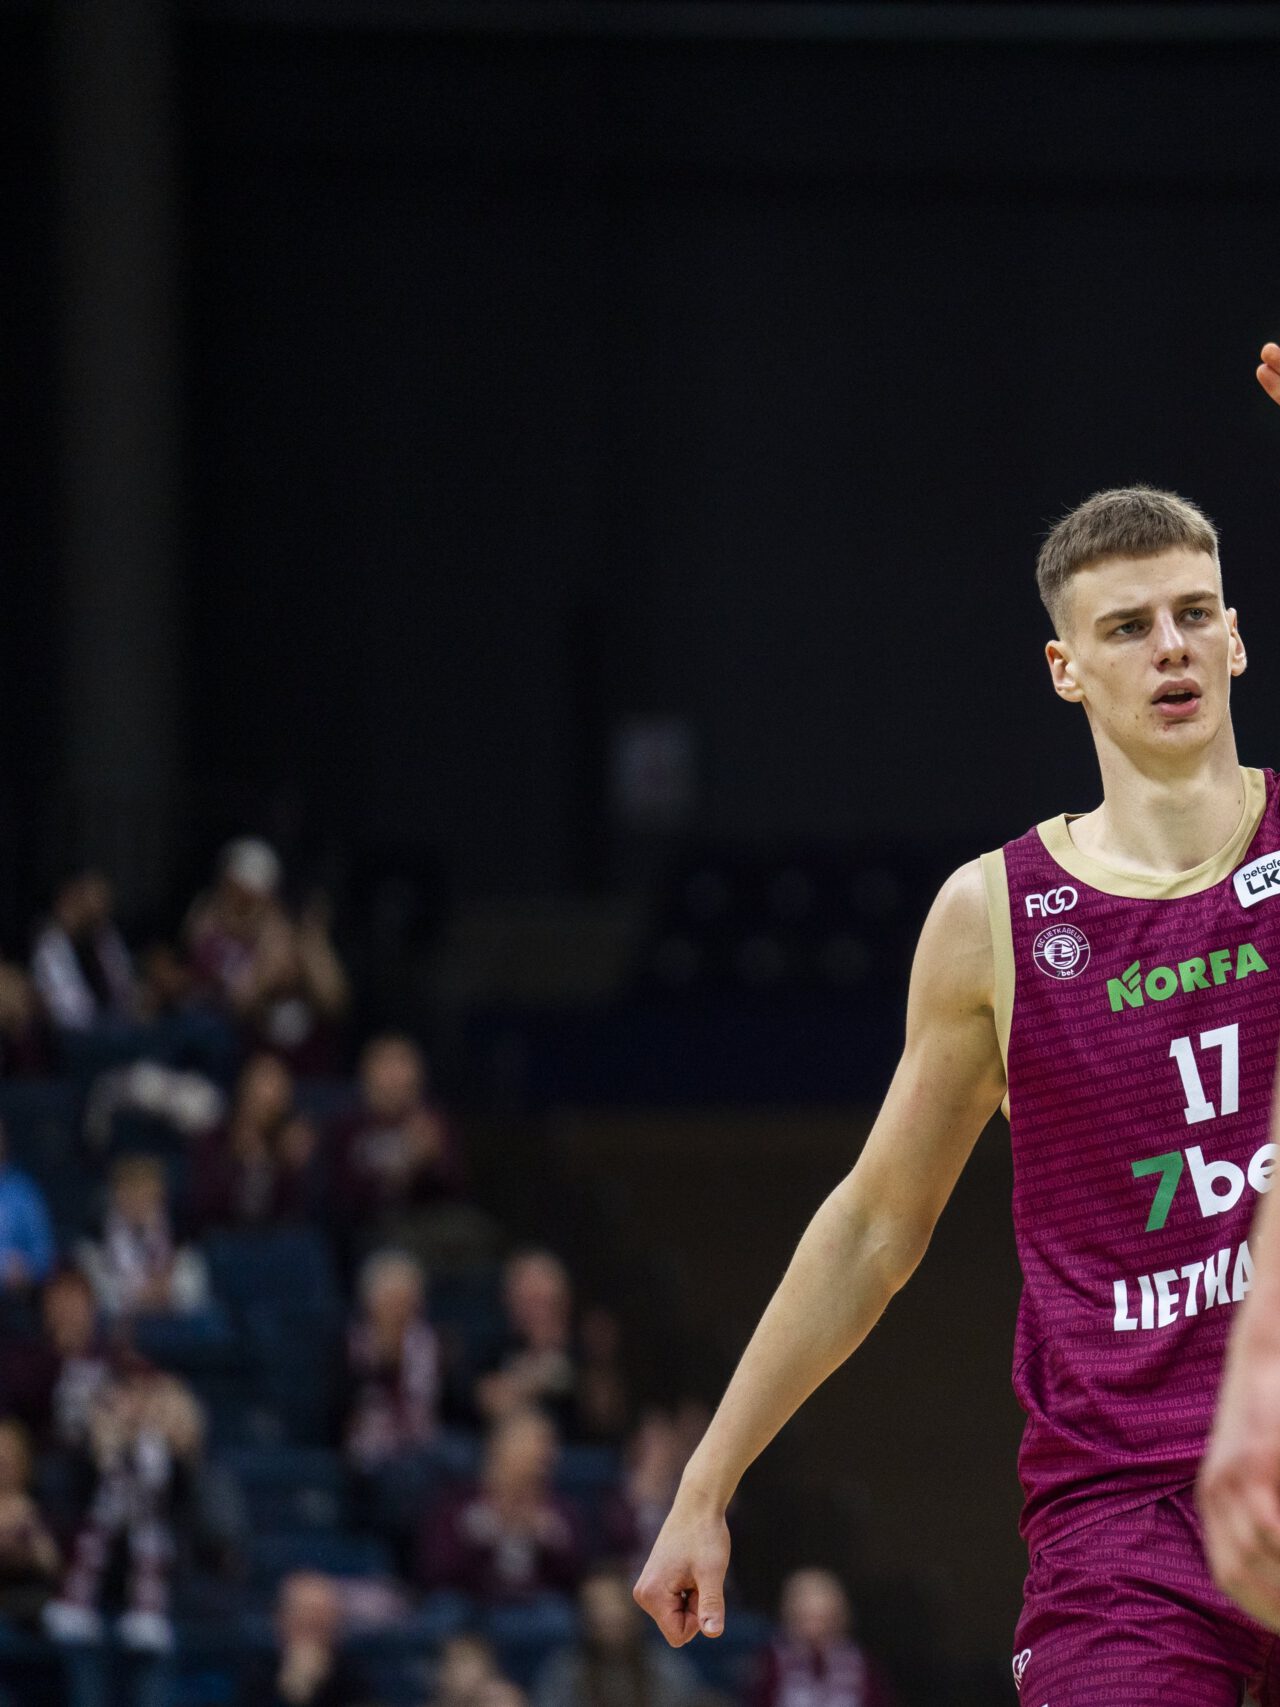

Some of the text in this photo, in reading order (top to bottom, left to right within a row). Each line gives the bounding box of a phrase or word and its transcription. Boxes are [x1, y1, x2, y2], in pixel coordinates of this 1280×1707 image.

[1106, 942, 1269, 1012] NORFA
[1168, 1023, 1240, 1125] 17
[1131, 1143, 1280, 1232] 7be
